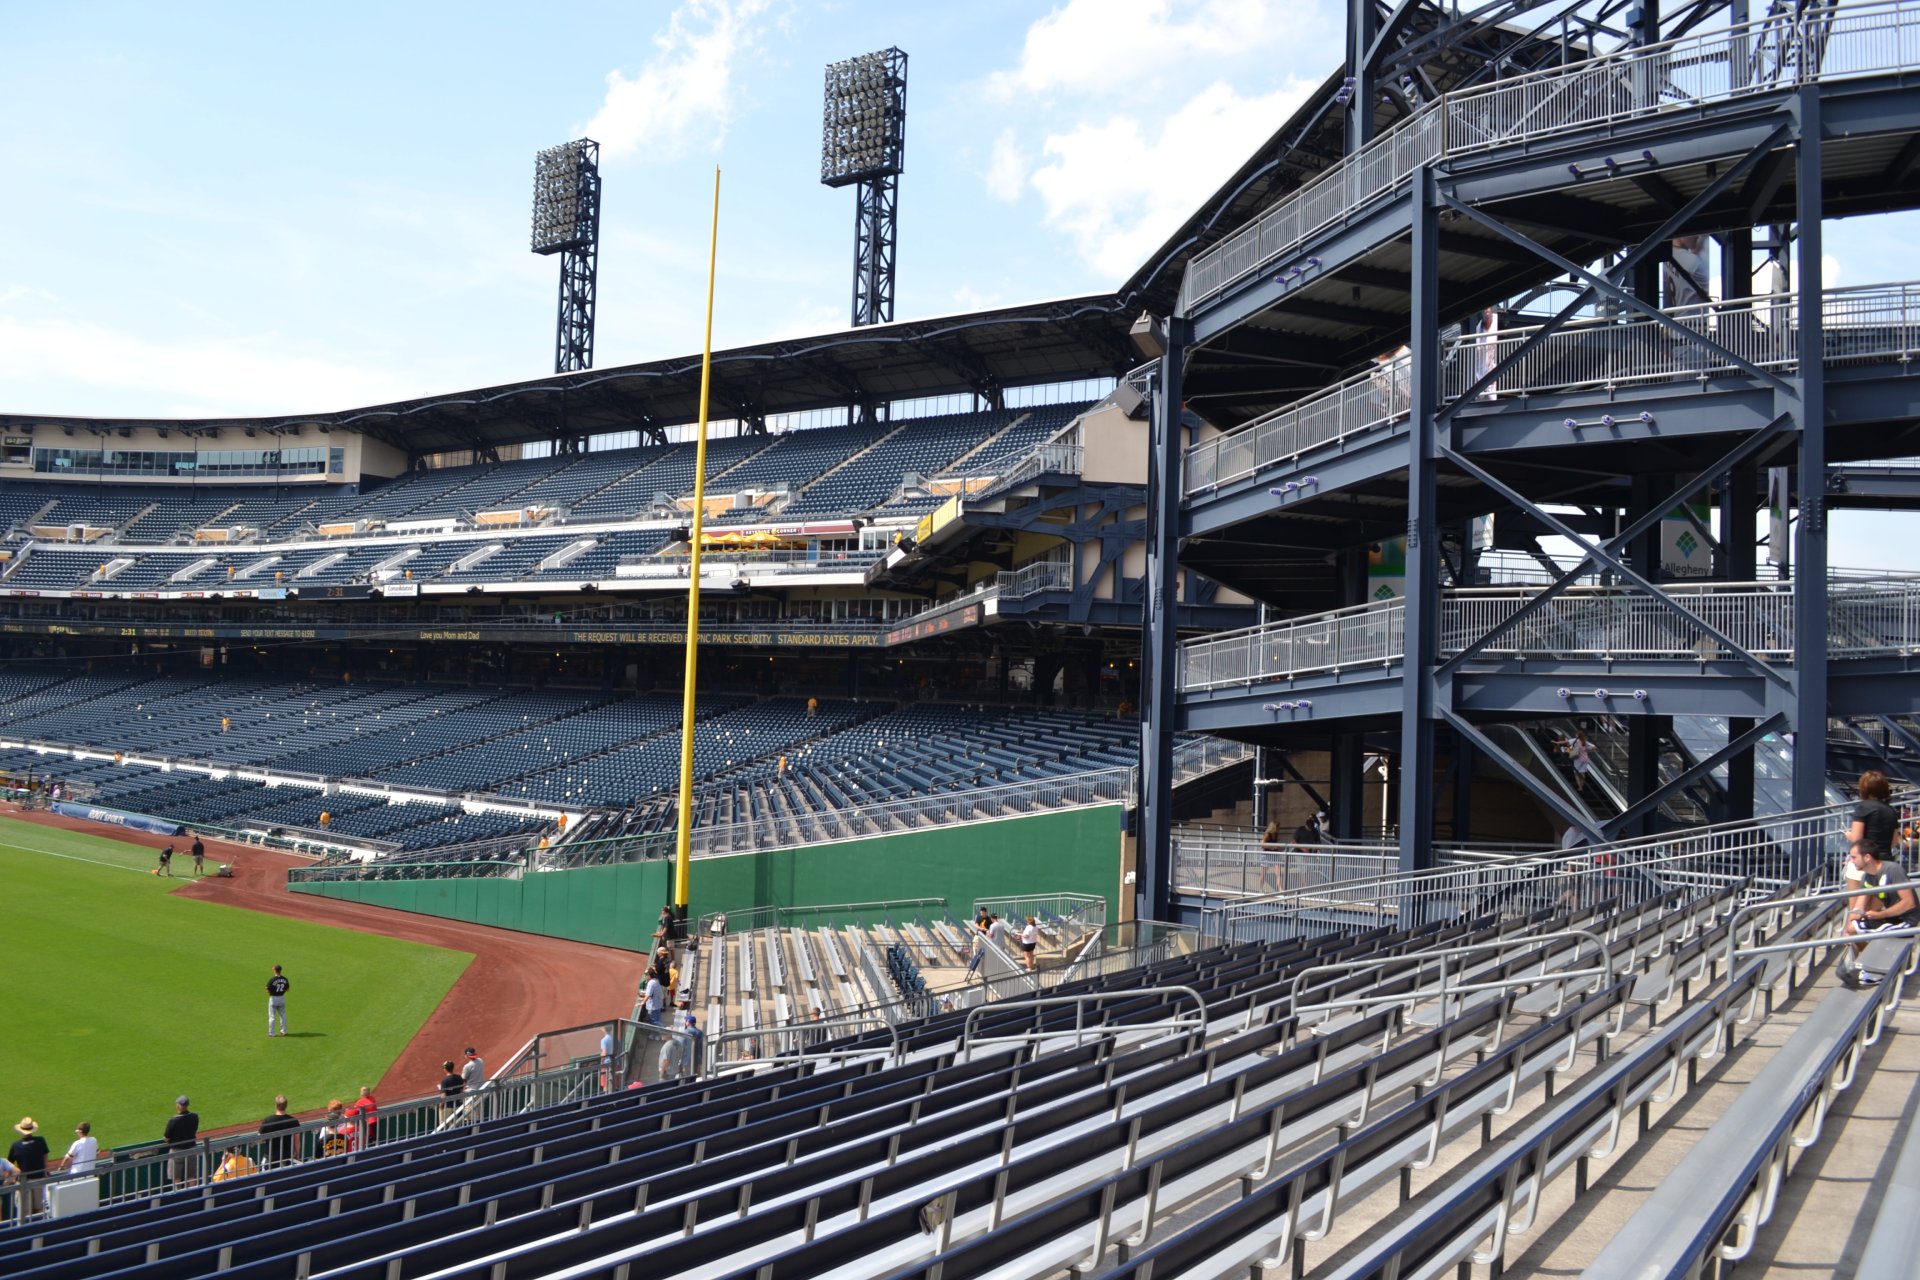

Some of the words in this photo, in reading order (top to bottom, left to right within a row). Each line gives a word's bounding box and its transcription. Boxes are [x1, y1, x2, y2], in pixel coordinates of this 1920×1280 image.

[1665, 563, 1709, 577] Allegheny
[326, 588, 344, 597] 2:31
[121, 628, 136, 636] 2:31
[240, 629, 251, 638] SEND
[252, 629, 264, 638] YOUR
[264, 629, 275, 638] TEXT
[275, 629, 294, 638] MESSAGE
[294, 630, 301, 638] TO
[420, 631, 432, 640] Love
[433, 632, 443, 641] you
[443, 632, 456, 640] Mom
[457, 631, 468, 640] and
[468, 631, 480, 640] Dad
[574, 632, 587, 642] THE
[588, 632, 618, 644] REQUEST
[619, 633, 636, 642] WILL
[637, 633, 647, 642] BE
[648, 633, 683, 643] RECEIVED
[697, 634, 711, 644] PNC
[712, 634, 732, 644] PARK
[733, 634, 773, 644] SECURITY.
[777, 634, 821, 645] STANDARD
[823, 634, 850, 645] RATES
[851, 634, 879, 645] APPLY.
[88, 809, 106, 820] ROOT
[104, 813, 125, 824] SPORTS
[276, 983, 285, 992] 72
